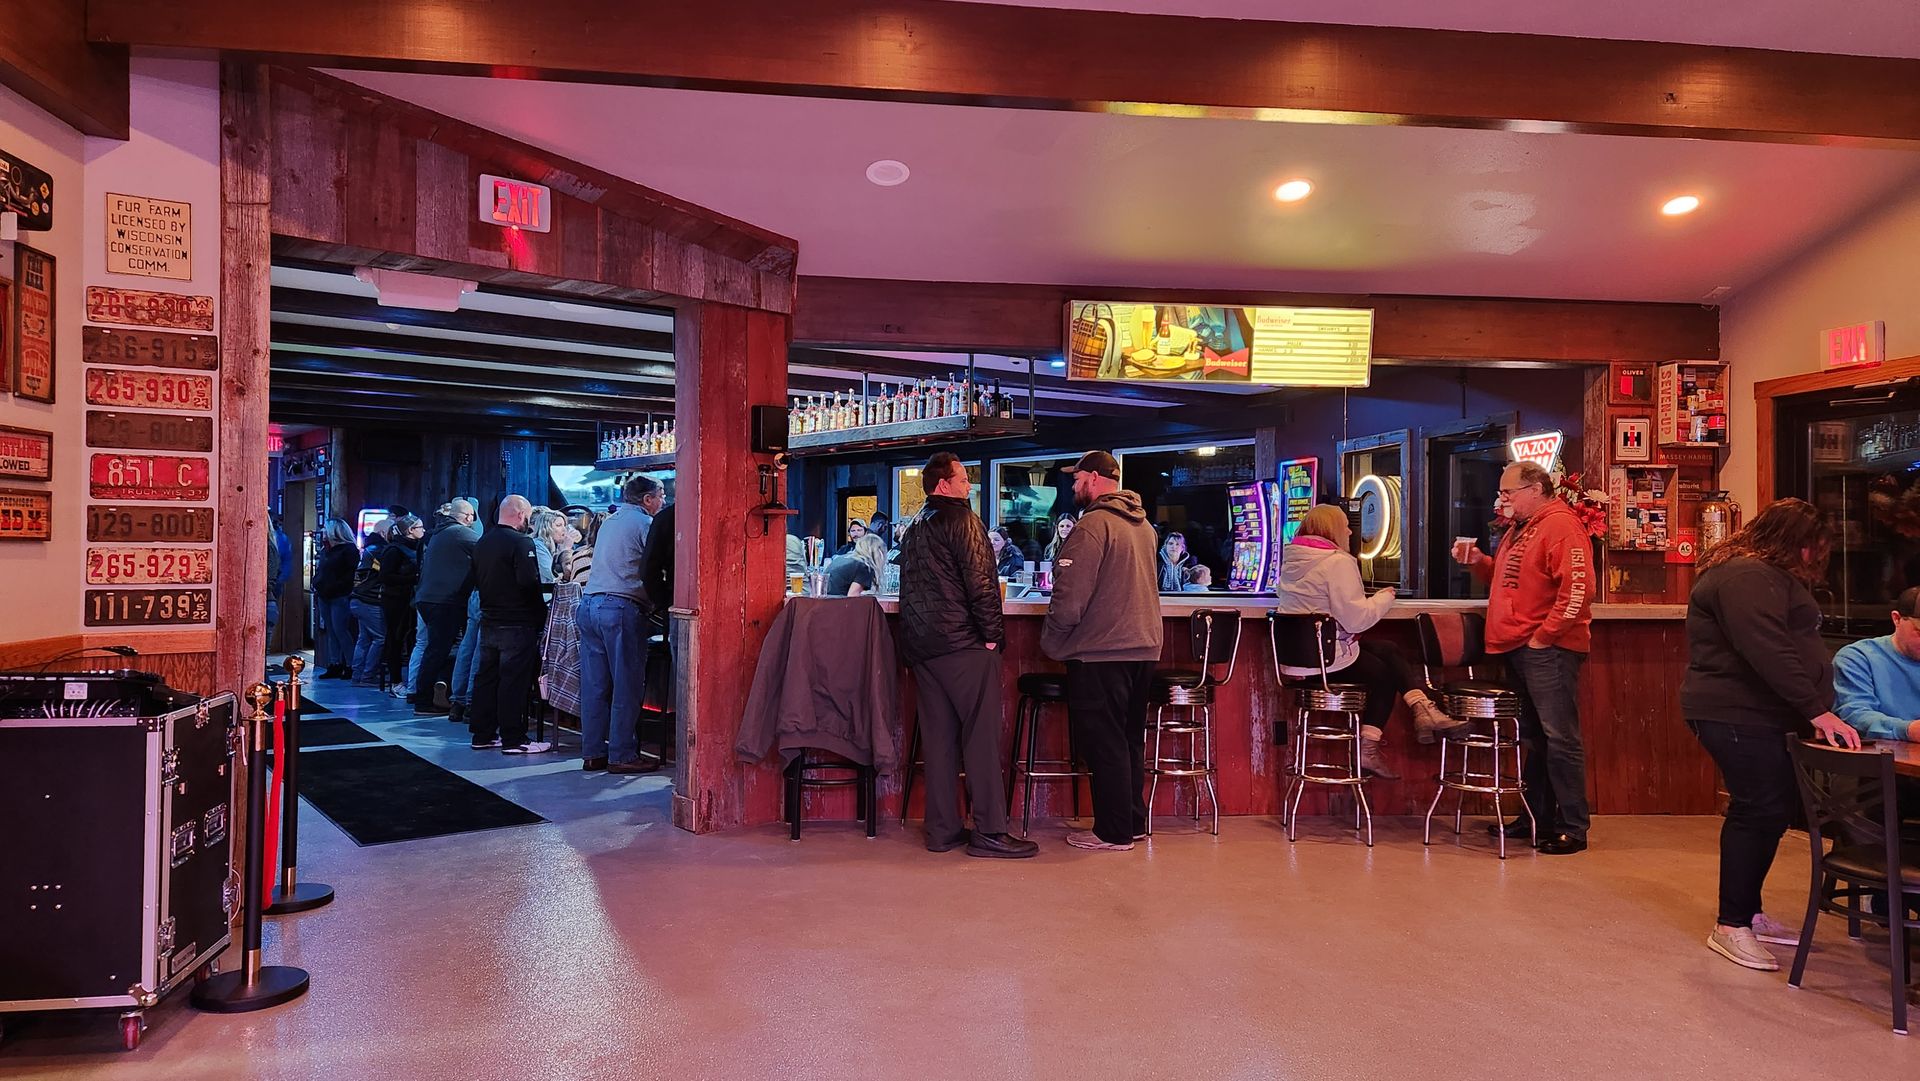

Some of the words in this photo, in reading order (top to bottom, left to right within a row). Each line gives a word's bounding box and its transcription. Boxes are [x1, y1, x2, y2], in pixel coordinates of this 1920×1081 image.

[117, 200, 141, 213] FUR
[149, 204, 181, 218] FARM
[493, 181, 543, 227] EXIT
[111, 214, 166, 231] LICENSED
[171, 219, 186, 233] BY
[116, 228, 183, 246] WISCONSIN
[110, 241, 188, 260] CONSERVATION
[128, 258, 171, 273] COMM.
[1828, 325, 1868, 364] EXIT
[1205, 357, 1248, 368] Budweiser
[90, 374, 190, 404] 265-930
[1661, 370, 1672, 435] SEVEN-UP
[1516, 439, 1554, 457] YAZOO
[108, 458, 154, 488] 851
[177, 463, 193, 487] C
[122, 487, 157, 496] TRUCK
[92, 512, 194, 538] 129-800
[91, 553, 191, 578] 265-929
[1571, 548, 1585, 568] USA
[93, 594, 190, 620] 111-739
[192, 611, 208, 620] 22
[1563, 583, 1585, 619] CANADA
